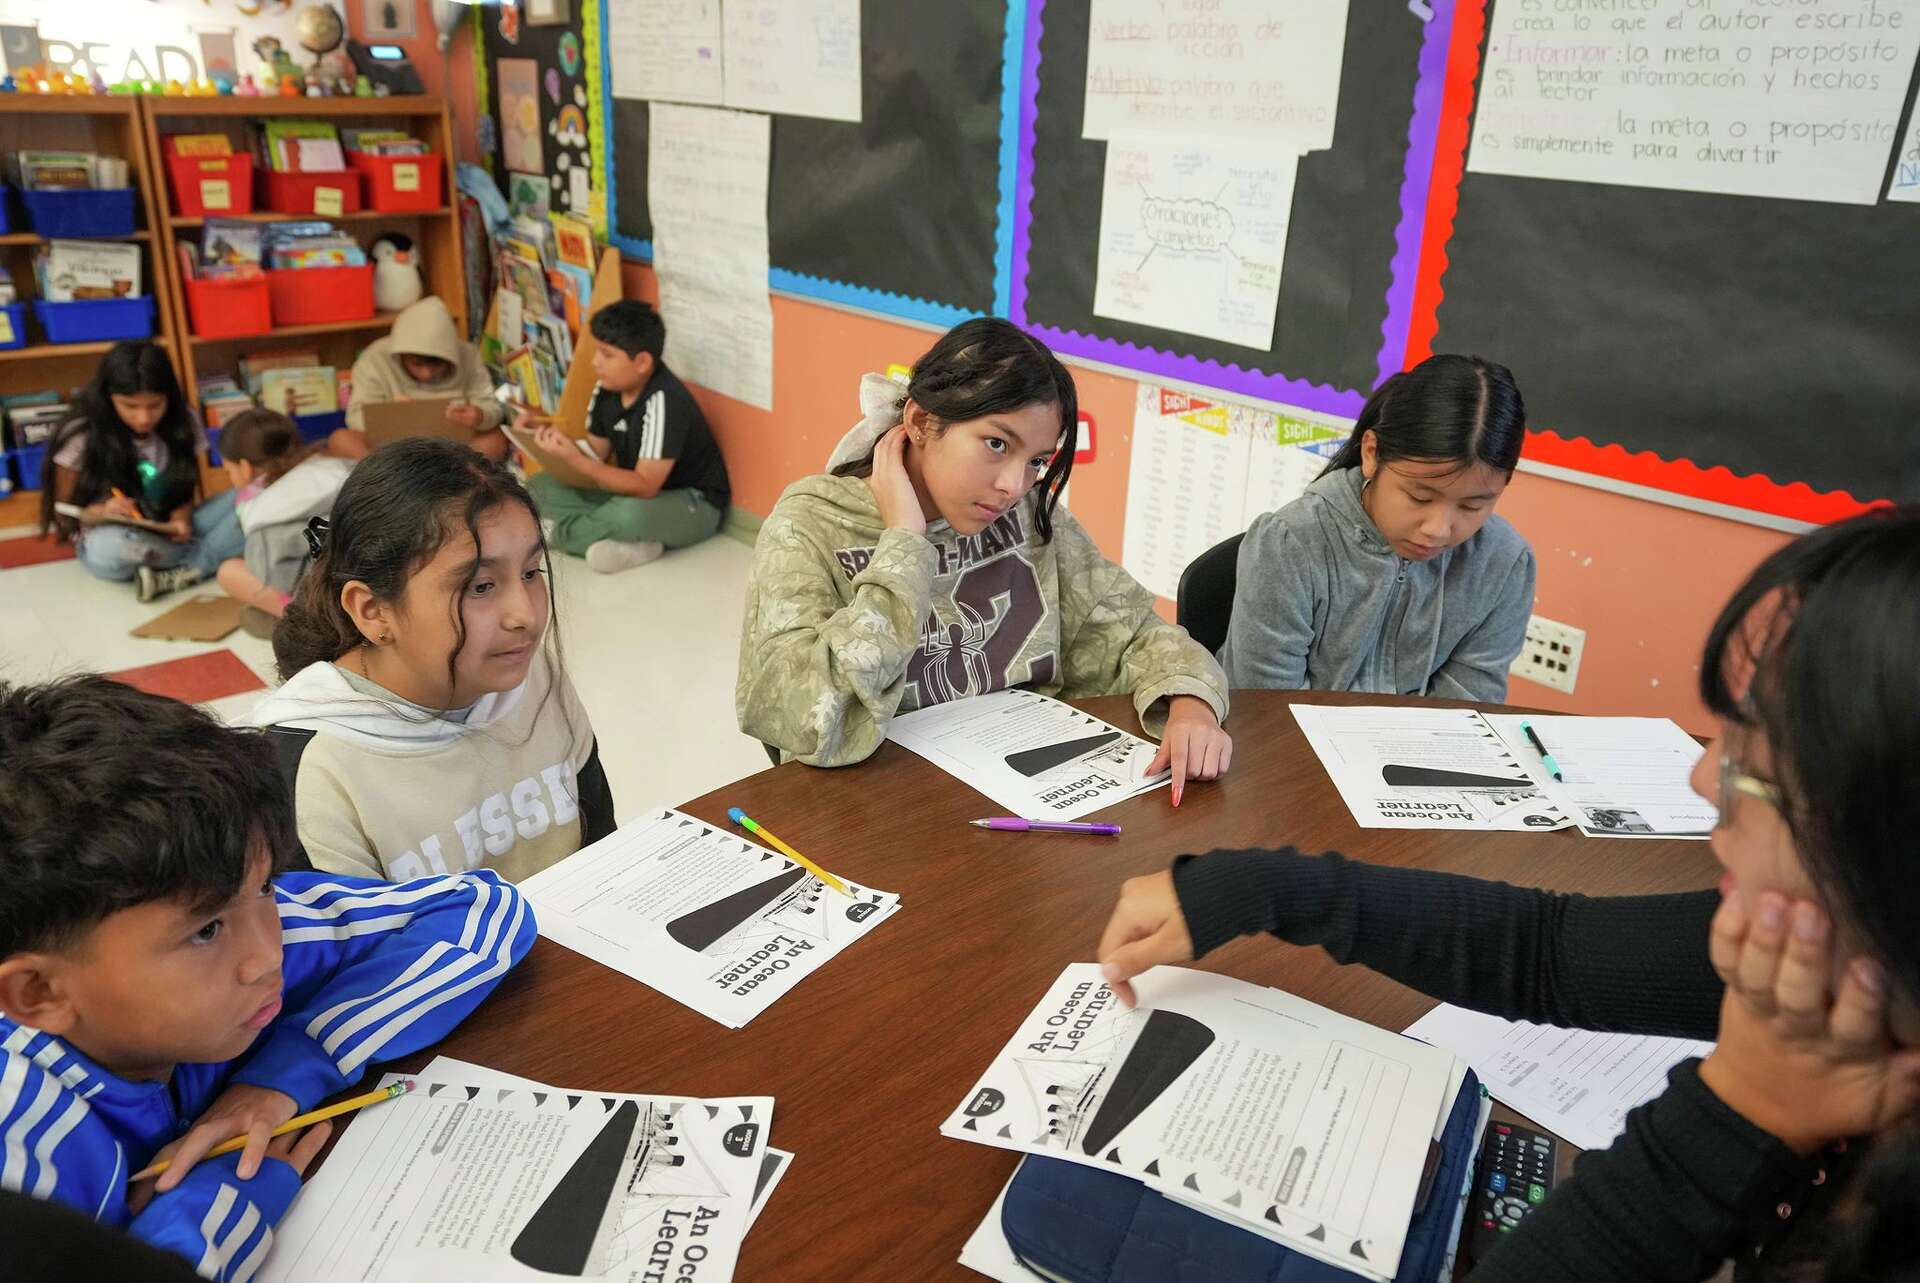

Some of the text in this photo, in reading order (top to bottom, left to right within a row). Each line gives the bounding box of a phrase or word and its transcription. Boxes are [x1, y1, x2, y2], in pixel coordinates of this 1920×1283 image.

[1512, 1, 1903, 35] crea lo que el autor escribe
[1665, 44, 1720, 63] meta
[1735, 46, 1752, 63] o
[1771, 40, 1898, 67] propósito
[1494, 82, 1600, 101] al lector
[1495, 64, 1881, 94] es brindar información y hechos
[1617, 109, 1637, 135] la
[1651, 116, 1710, 138] meta
[1729, 121, 1747, 138] o
[1512, 135, 1615, 155] simplemente
[1632, 142, 1678, 161] para
[1697, 141, 1783, 165] divertir
[1164, 394, 1190, 411] SIGHT
[1283, 423, 1314, 440] SIGHT
[1038, 773, 1107, 804] Learner
[1051, 778, 1122, 812] An Ocean
[1376, 801, 1464, 813] Learner
[1381, 811, 1475, 822] An Ocean
[714, 934, 797, 990] Learner
[783, 939, 815, 958] An
[731, 958, 790, 997] Ocean
[1028, 980, 1094, 1054] An Ocean
[1053, 981, 1114, 1052] Learner
[690, 1205, 721, 1238] An
